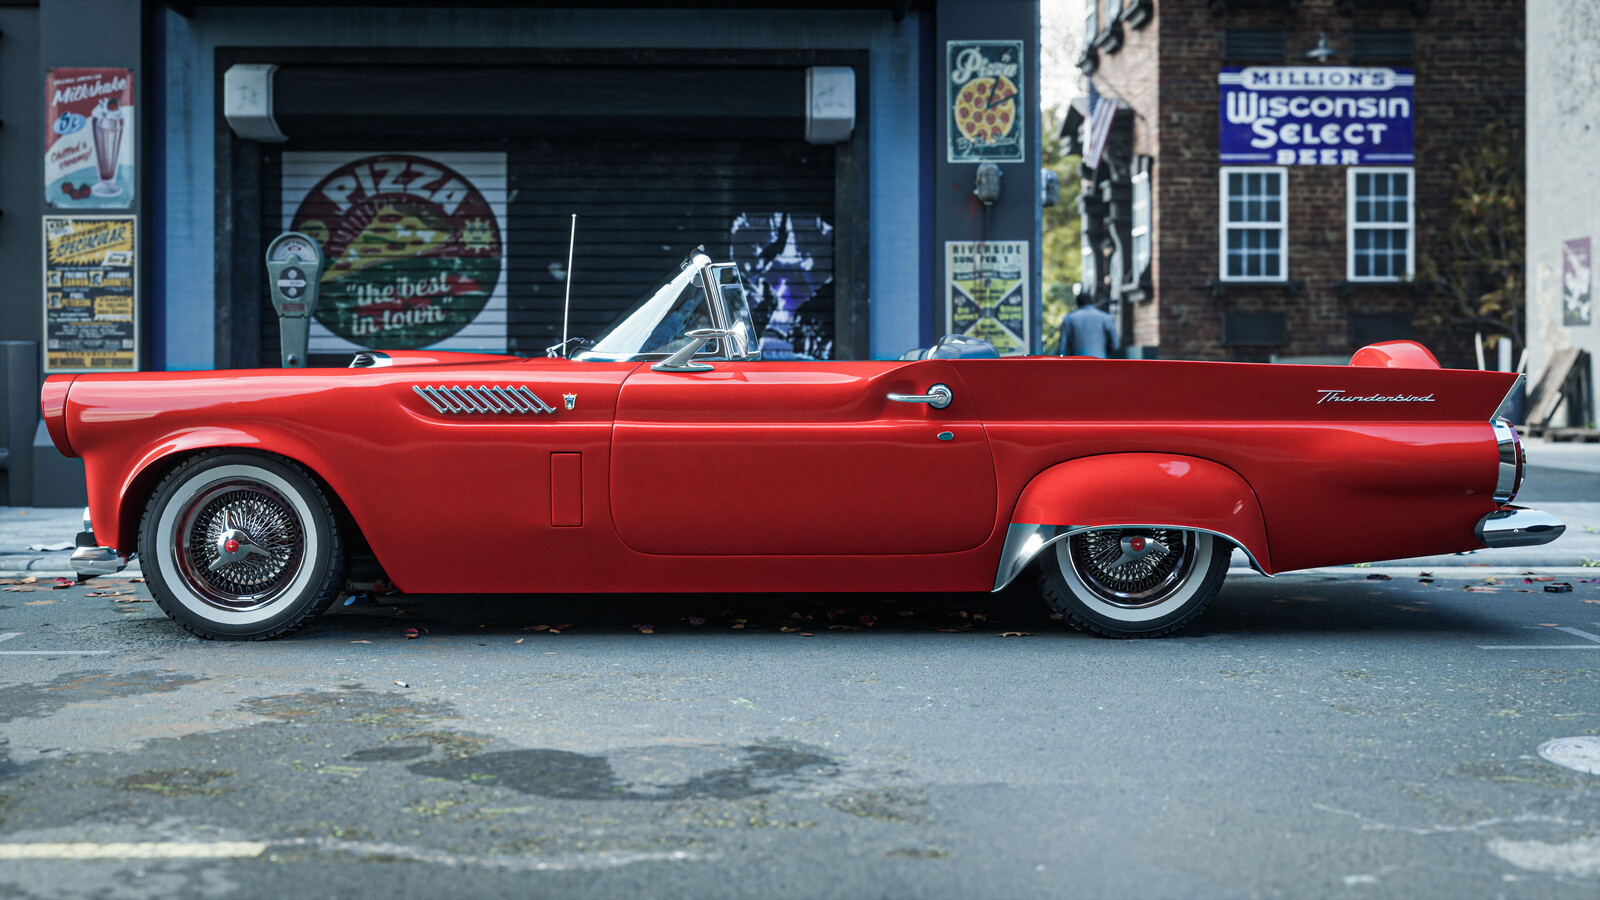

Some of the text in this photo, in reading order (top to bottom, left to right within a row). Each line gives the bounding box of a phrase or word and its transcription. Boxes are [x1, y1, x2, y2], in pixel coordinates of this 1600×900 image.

[952, 46, 1018, 84] Pizza
[1252, 71, 1386, 86] MILLION'S
[52, 76, 127, 107] Milkshake
[1276, 149, 1360, 165] BEER
[321, 161, 470, 217] PIZZA
[54, 226, 127, 258] SPECTACULAR
[953, 245, 1022, 255] RIVERSIDE
[397, 271, 451, 298] best
[351, 312, 379, 336] in
[1317, 389, 1435, 404] Thunderbird
